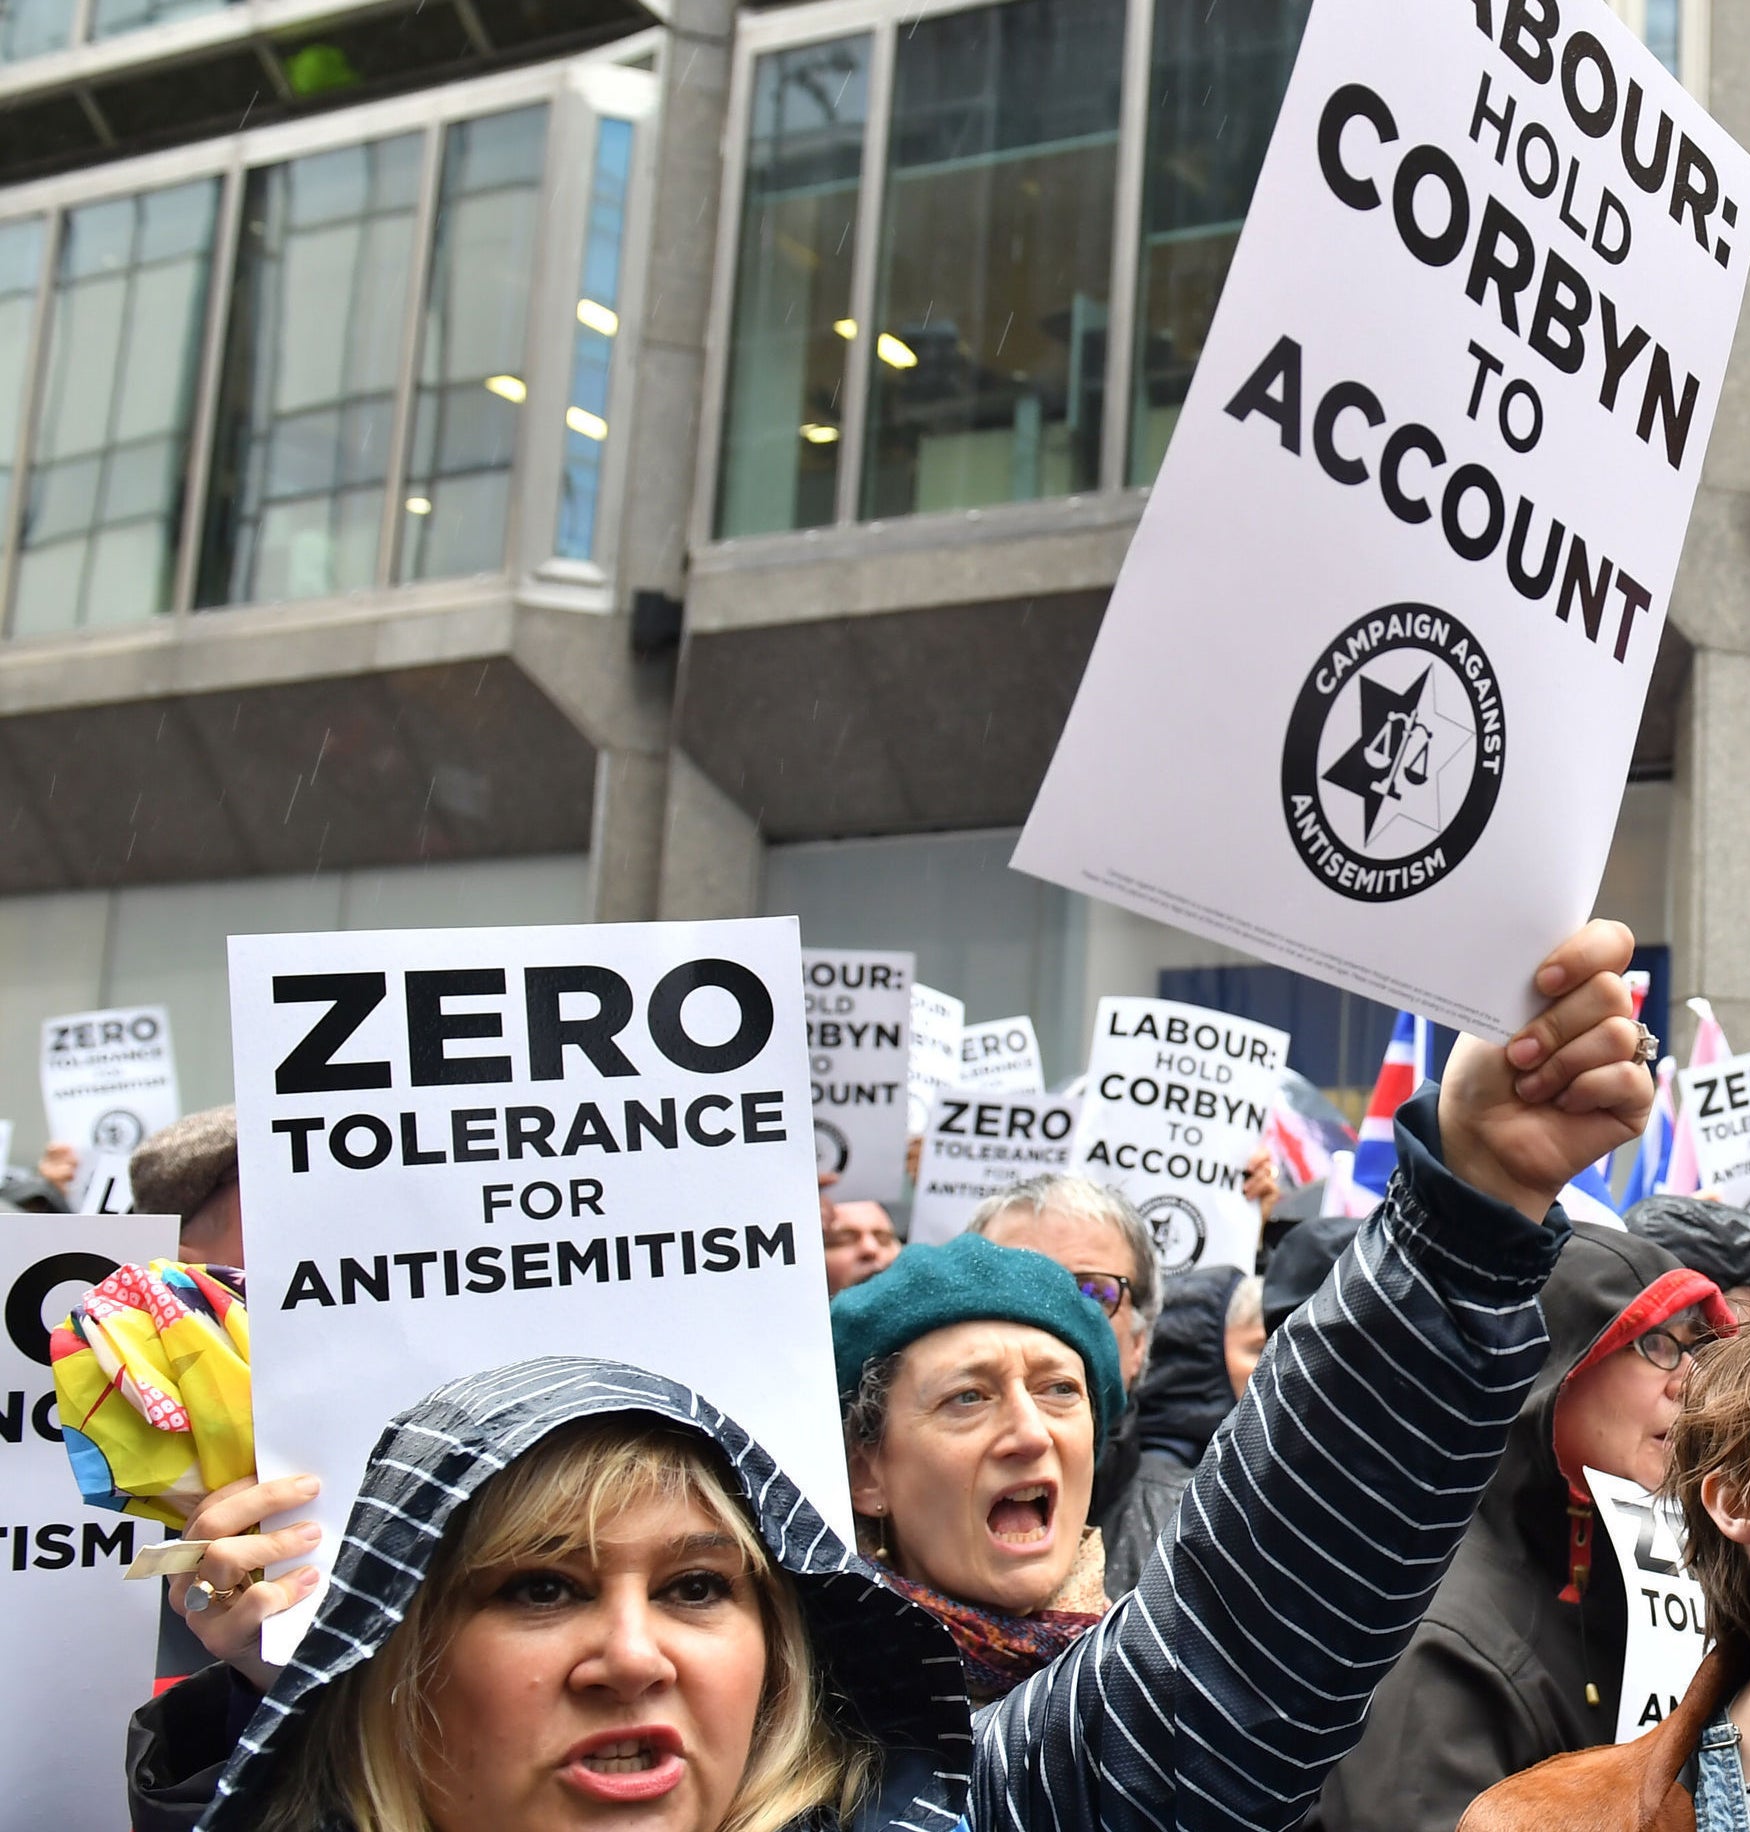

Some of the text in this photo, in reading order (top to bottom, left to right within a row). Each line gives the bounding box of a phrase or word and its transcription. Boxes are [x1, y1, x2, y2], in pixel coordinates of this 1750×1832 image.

[1471, 0, 1738, 269] BOUR:
[1469, 70, 1631, 265] HOLD
[1317, 82, 1700, 471] CORBYN
[1468, 338, 1543, 453] TO
[1223, 333, 1653, 663] ACCOUNT
[1316, 612, 1501, 774] CAMPAIGN AGAINST
[1291, 795, 1446, 893] ANTISEMITISM
[803, 963, 903, 990] OUR:
[805, 994, 855, 1015] OLD
[51, 1017, 157, 1050] ZERO
[272, 957, 775, 1095] ZERO
[962, 1030, 1027, 1062] ERO
[1109, 1011, 1277, 1070] LABOUR:
[811, 1082, 899, 1104] OUNT
[1156, 1052, 1232, 1084] HOLD
[939, 1101, 1072, 1141] ZERO
[1100, 1074, 1266, 1132] CORBYN
[272, 1091, 788, 1174] TOLERANCE
[934, 1140, 1067, 1163] TOLERANCE
[1168, 1122, 1203, 1146] TO
[482, 1178, 605, 1224] FOR
[280, 1221, 797, 1311] ANTISEMITISM
